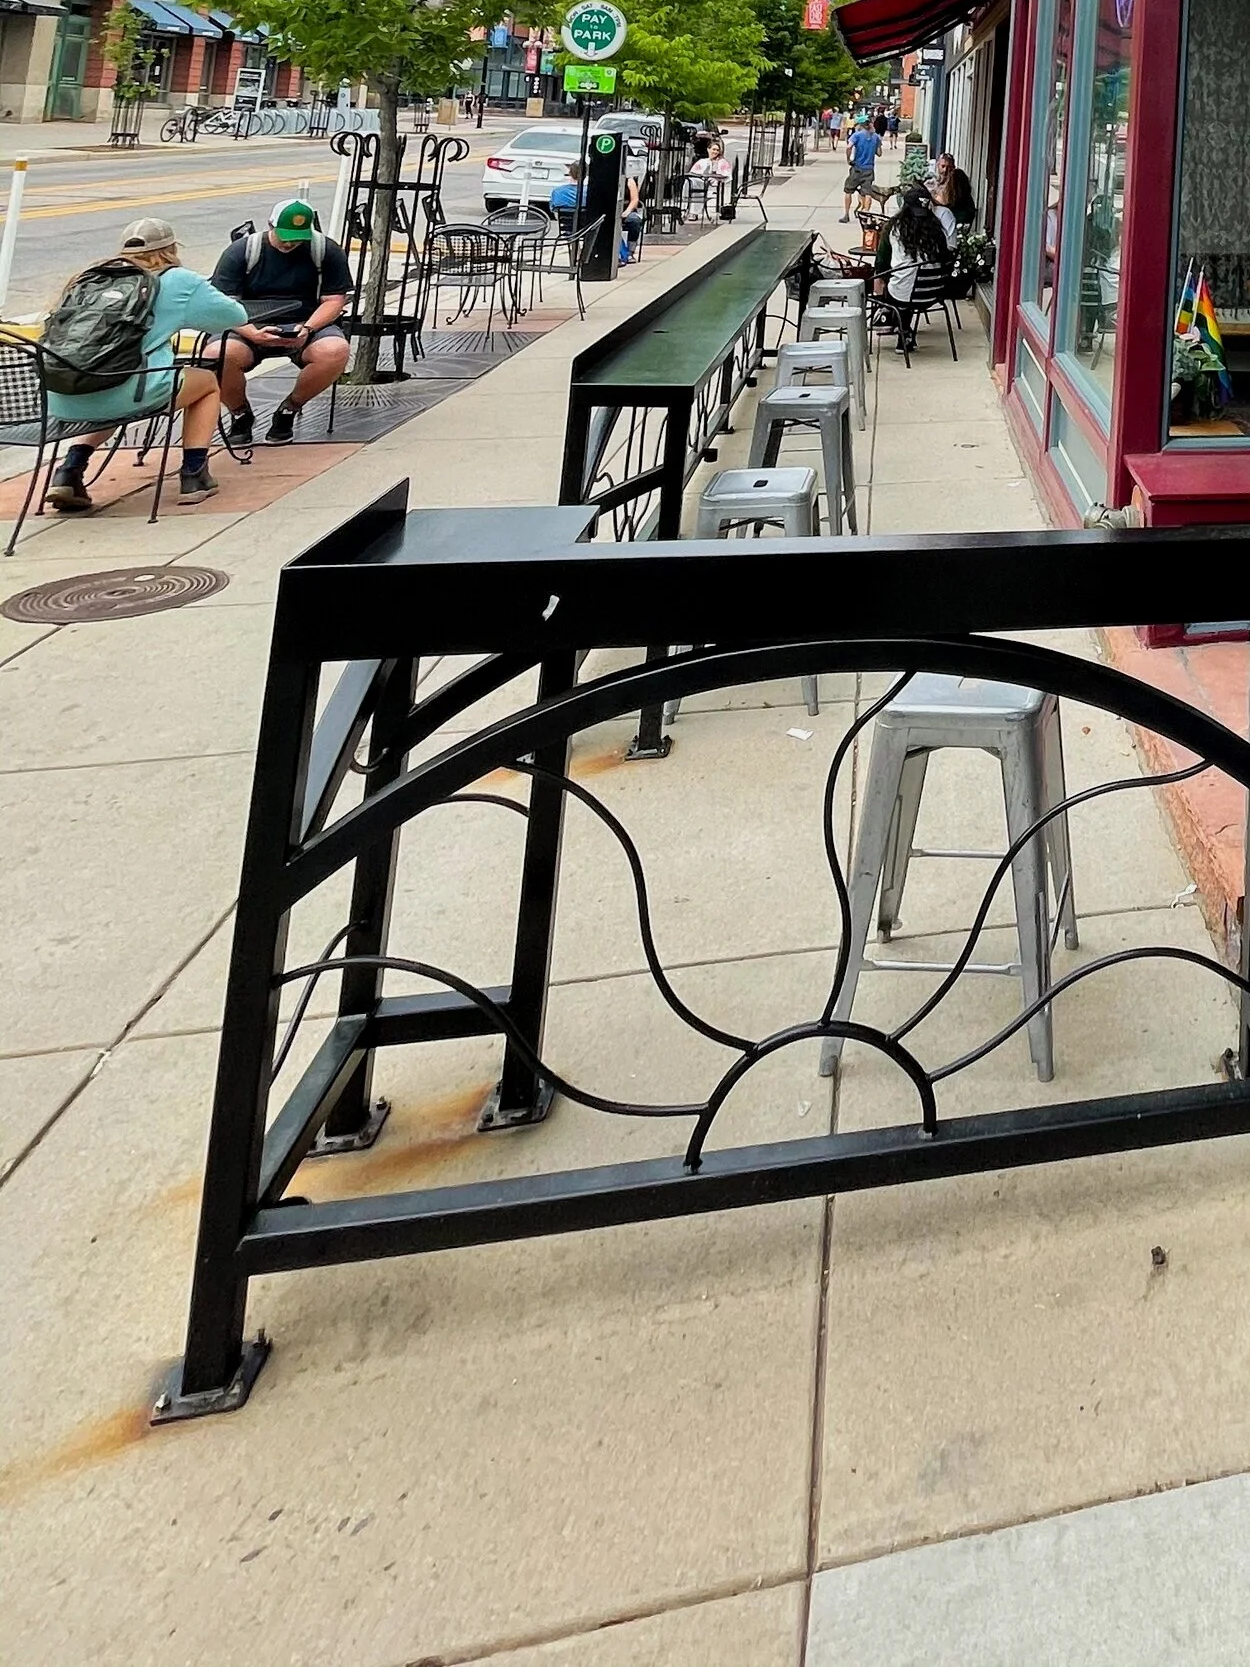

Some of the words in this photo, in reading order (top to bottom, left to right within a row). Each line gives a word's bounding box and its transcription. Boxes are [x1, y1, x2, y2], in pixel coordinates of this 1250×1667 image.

[581, 14, 607, 23] PAY
[573, 29, 611, 41] PARK
[601, 138, 612, 150] P
